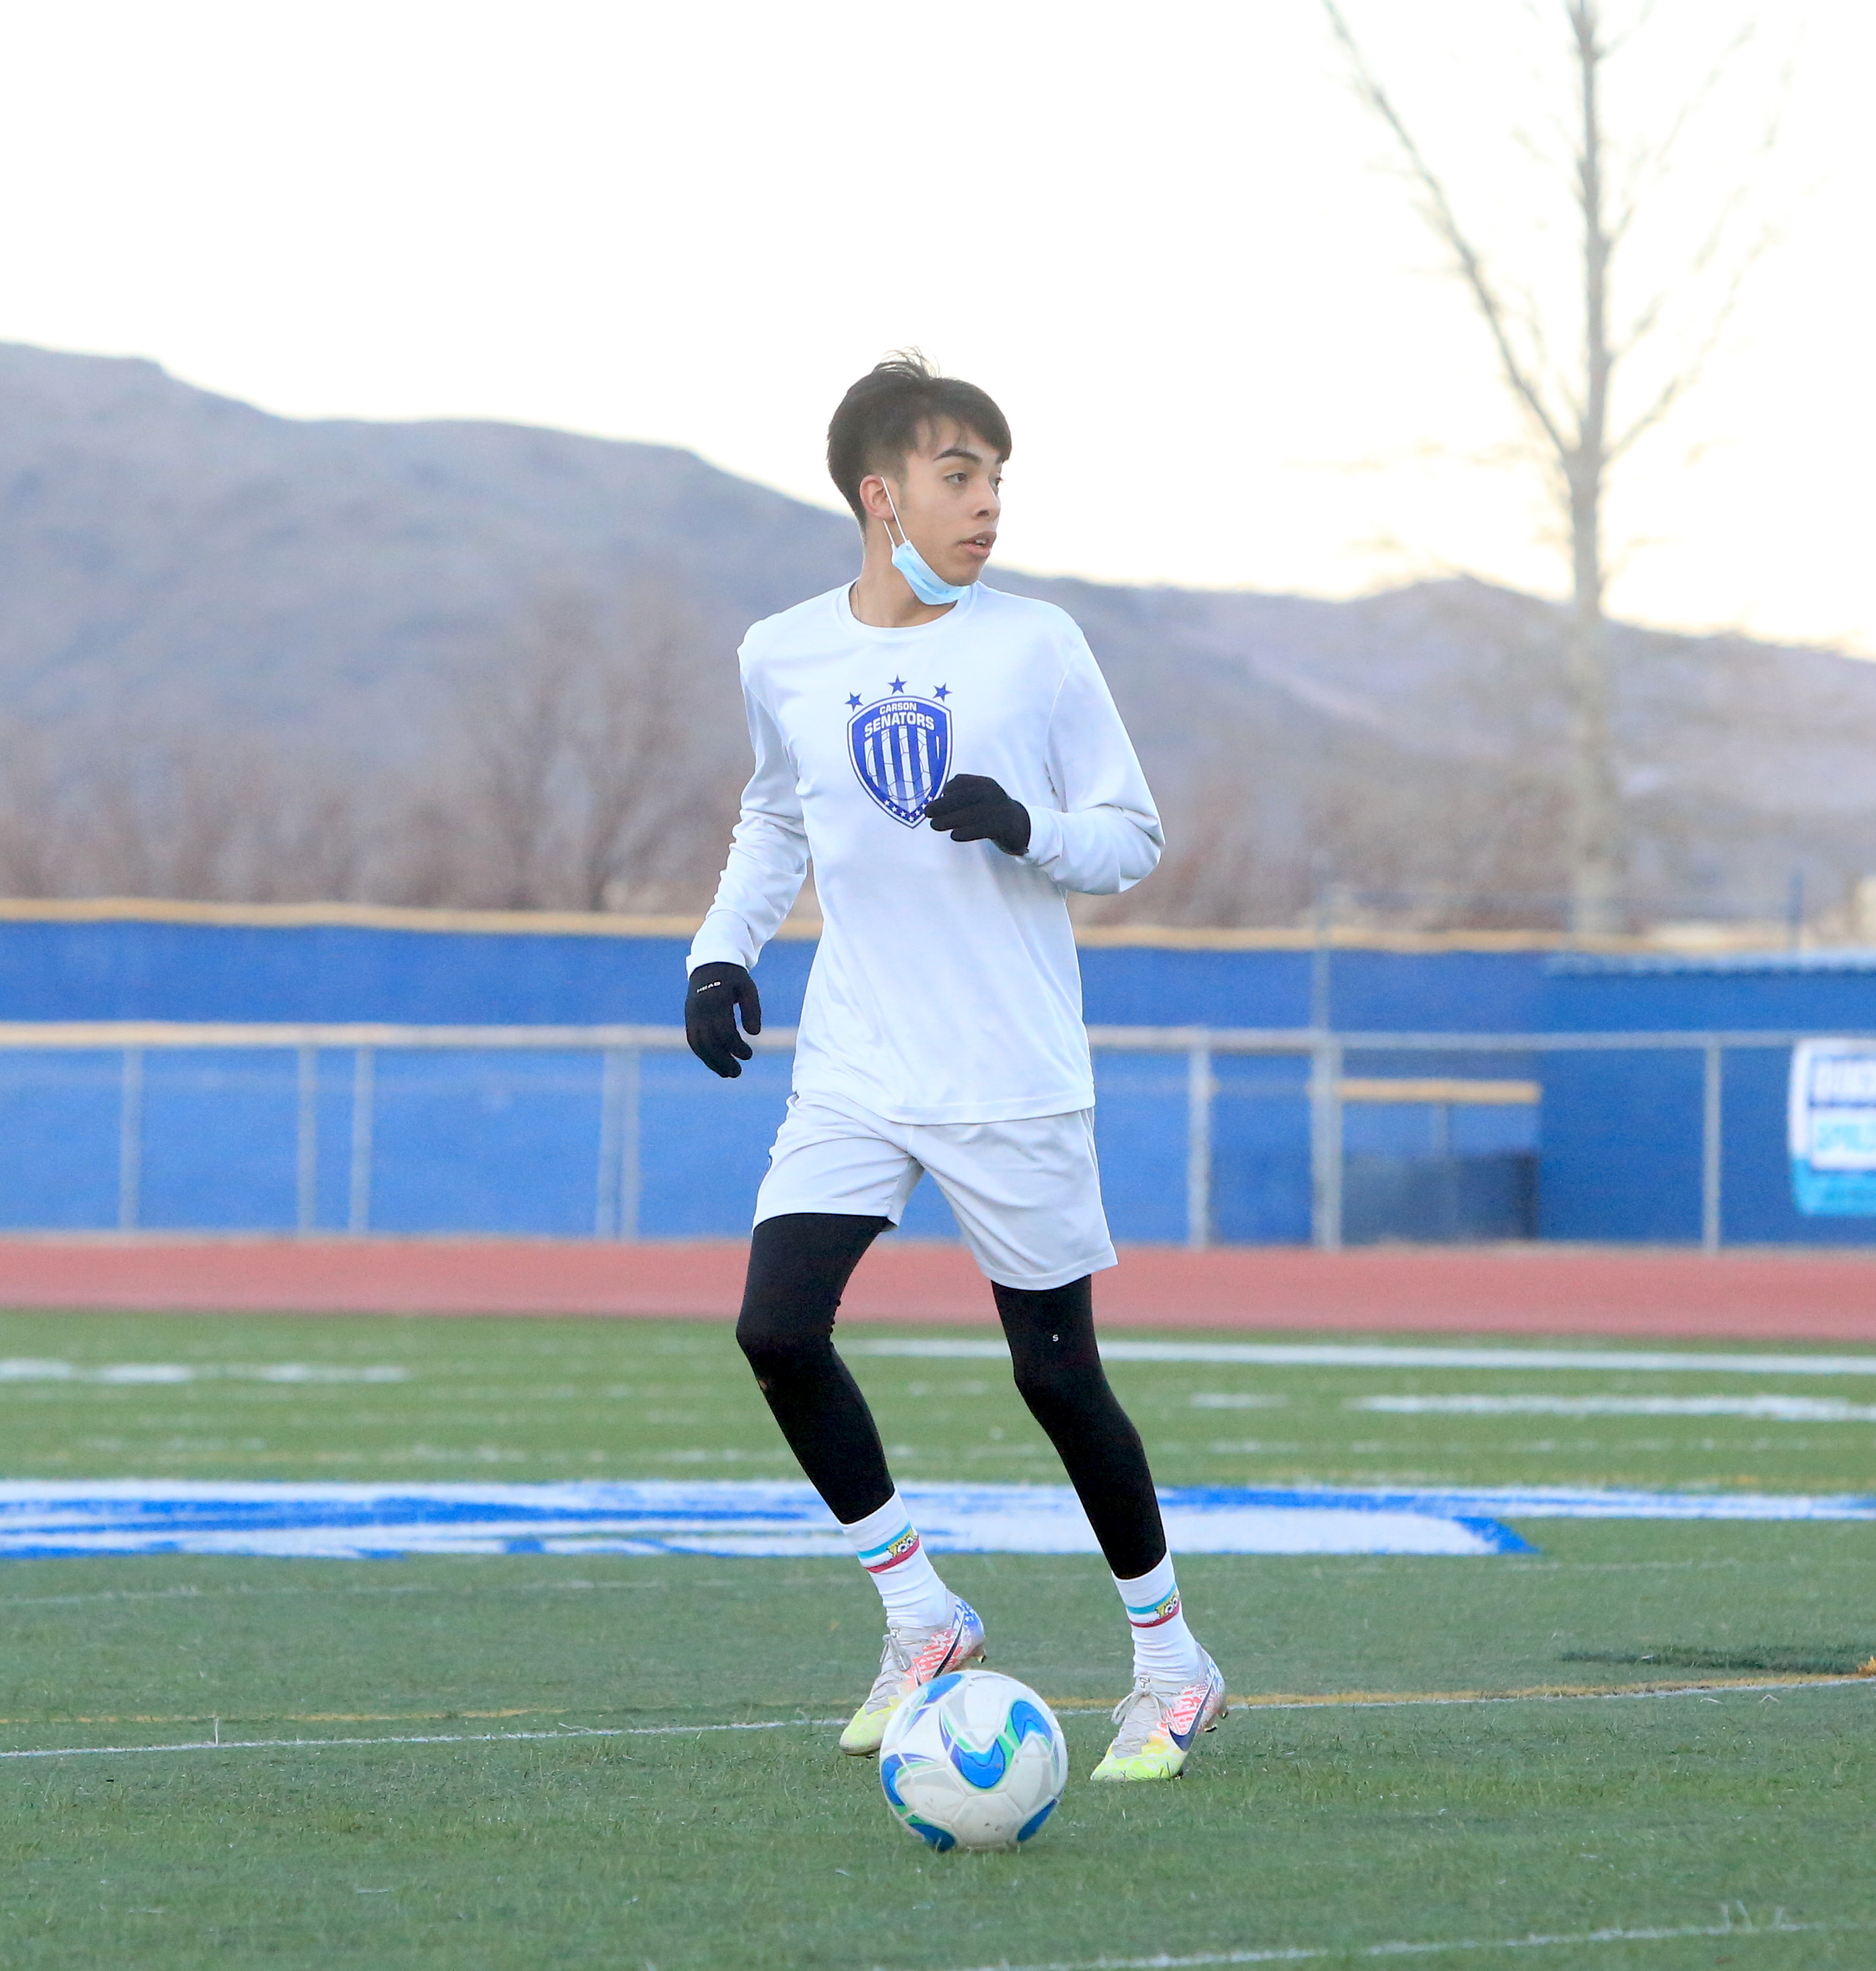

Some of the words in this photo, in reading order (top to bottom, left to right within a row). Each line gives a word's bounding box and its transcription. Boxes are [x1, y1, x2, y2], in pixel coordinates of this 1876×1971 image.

[880, 702, 917, 715] CARSON
[864, 712, 935, 738] SENATORS
[697, 981, 721, 993] HEAD
